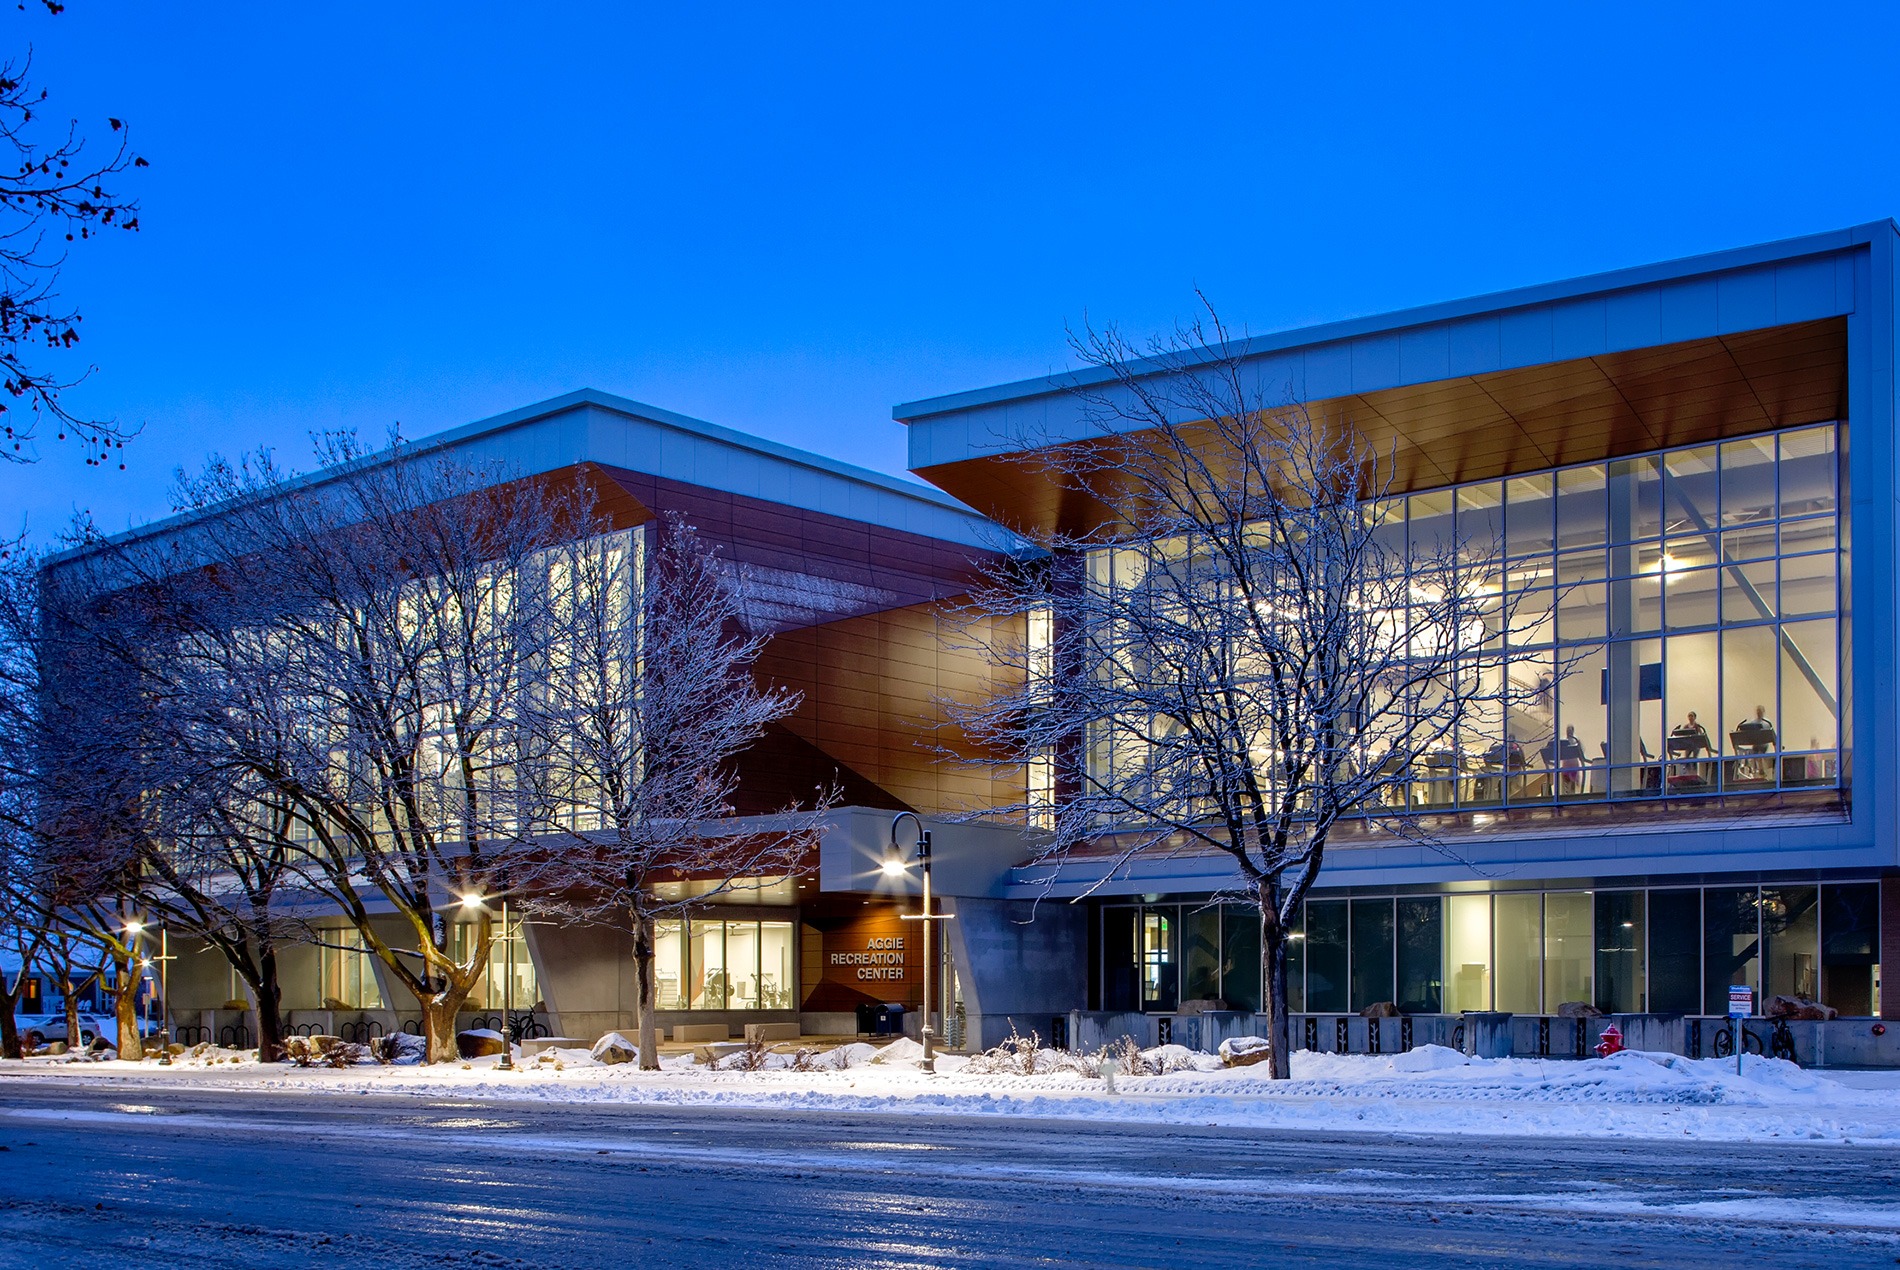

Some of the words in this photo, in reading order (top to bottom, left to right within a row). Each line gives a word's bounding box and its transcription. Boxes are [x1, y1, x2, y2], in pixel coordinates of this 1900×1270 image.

[867, 938, 904, 949] AGGIE
[831, 953, 904, 965] RECREATION
[857, 967, 904, 979] CENTER
